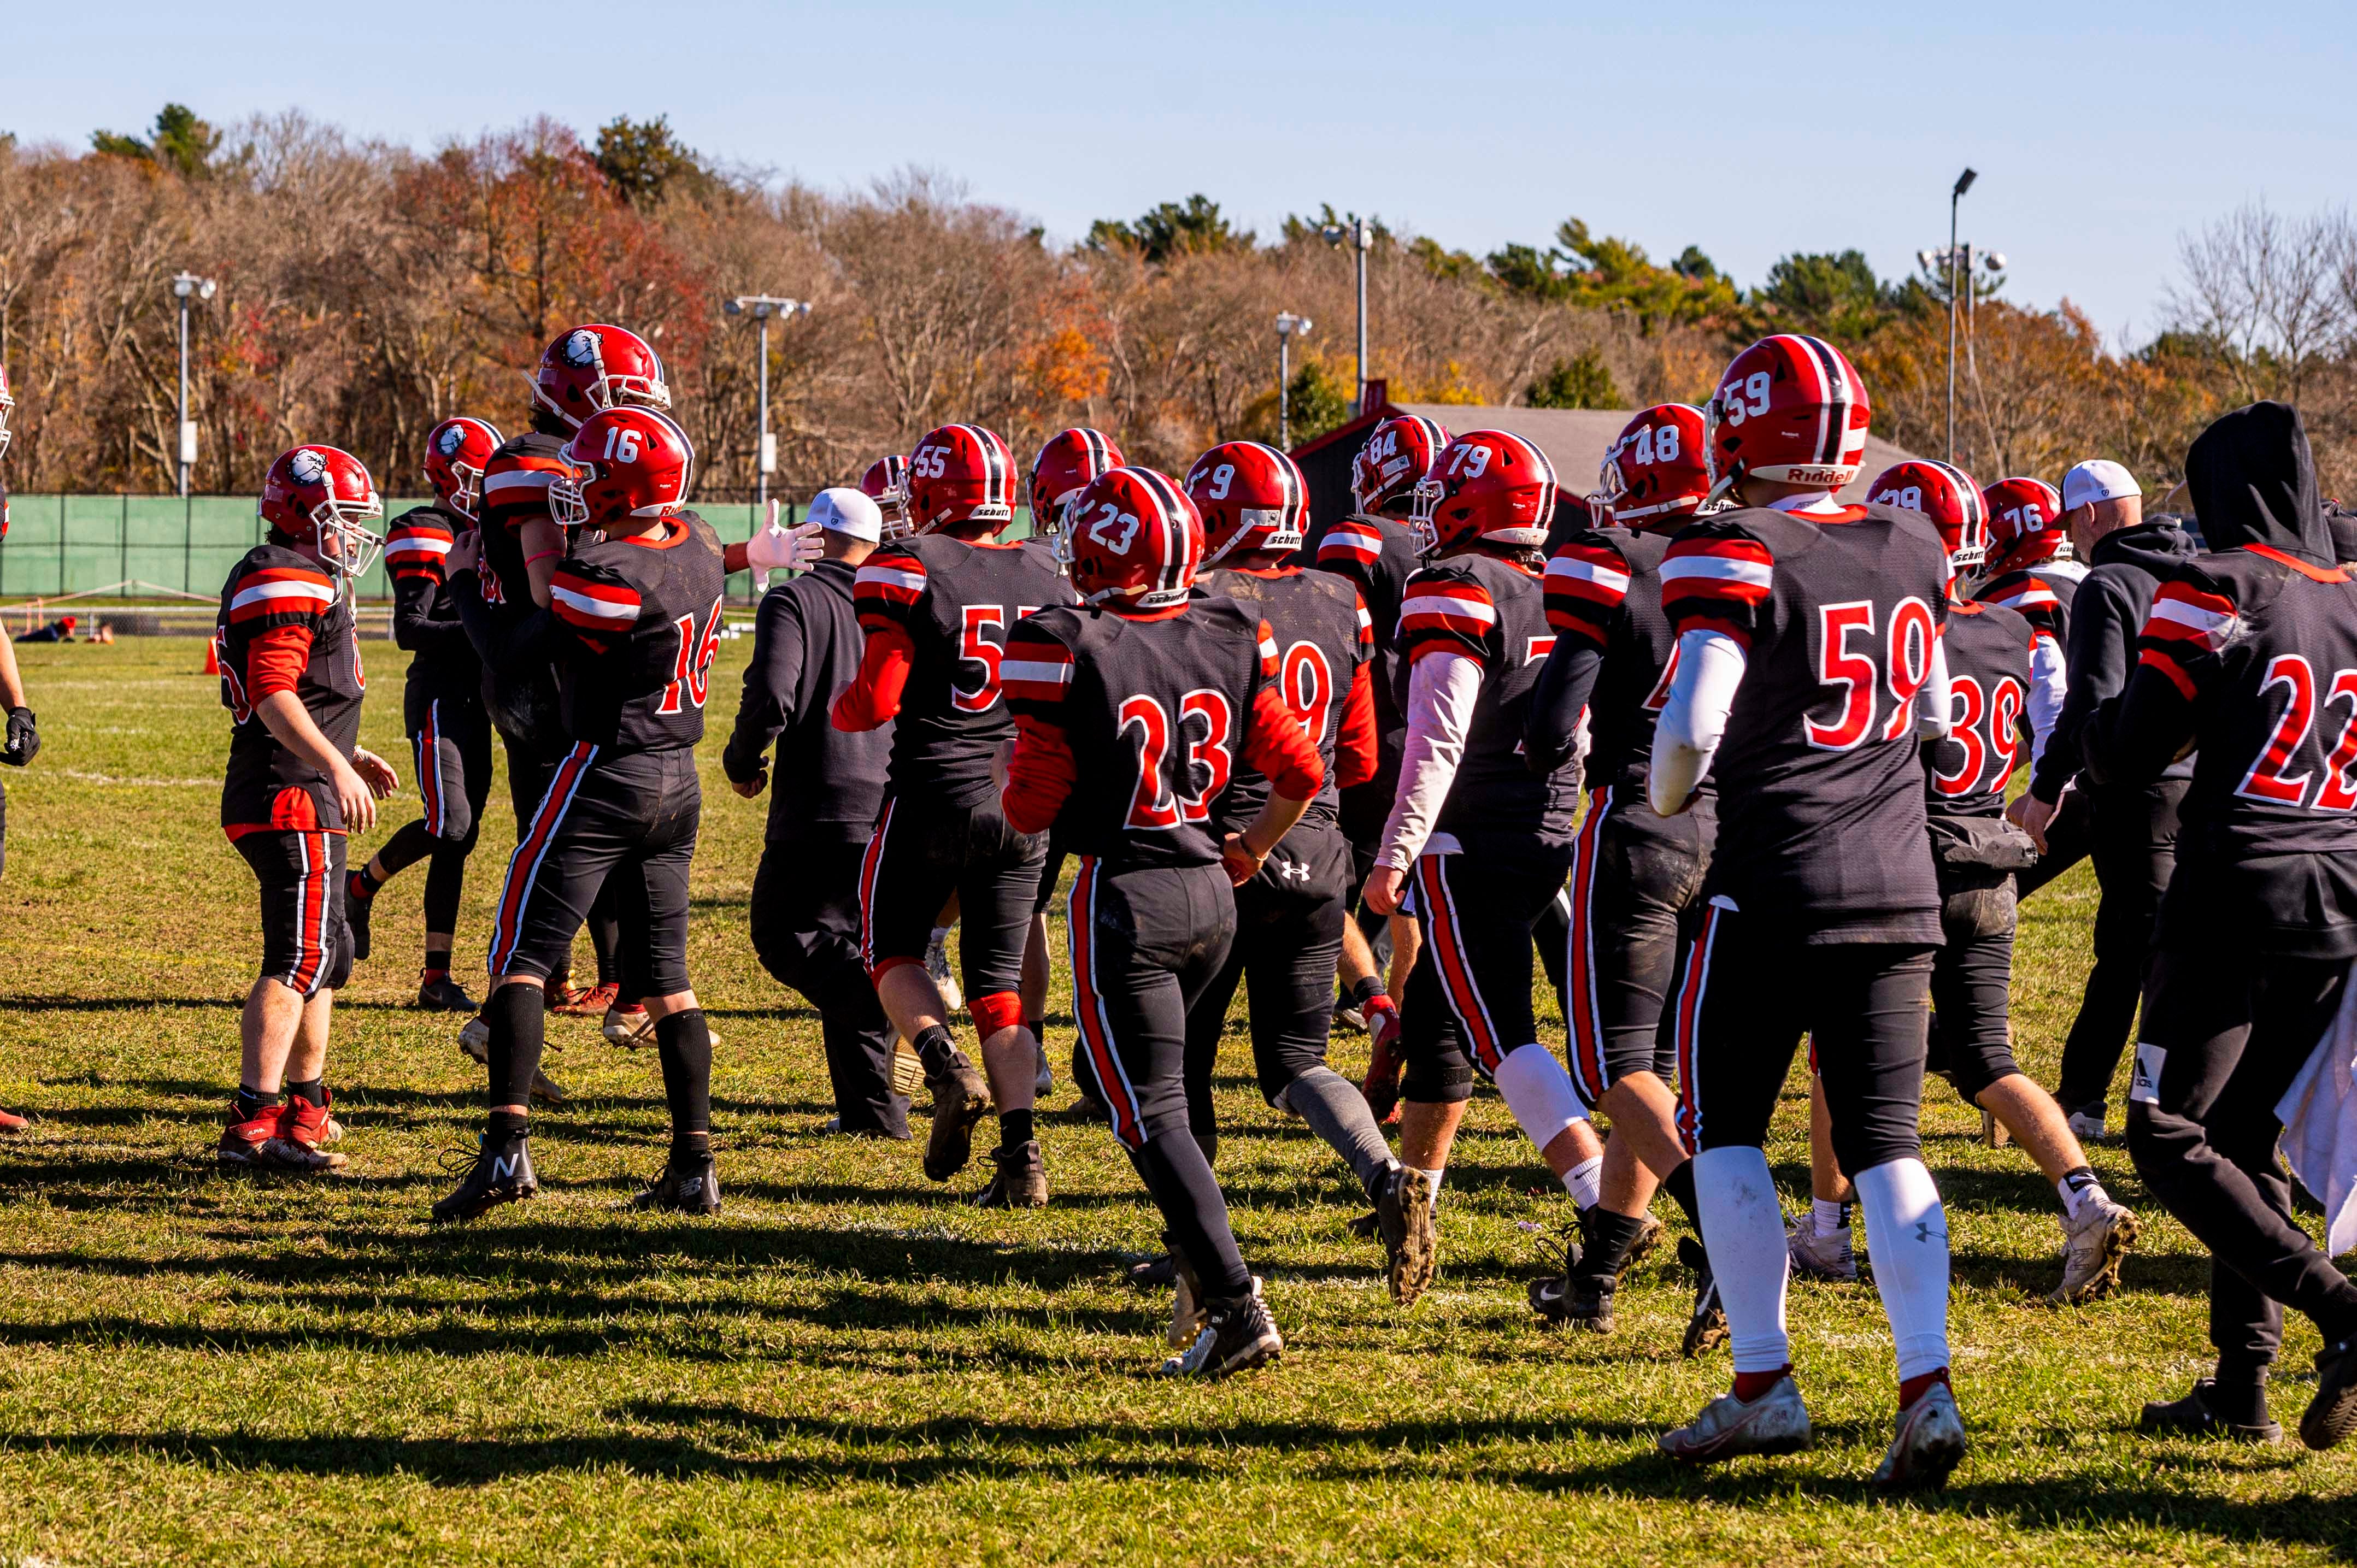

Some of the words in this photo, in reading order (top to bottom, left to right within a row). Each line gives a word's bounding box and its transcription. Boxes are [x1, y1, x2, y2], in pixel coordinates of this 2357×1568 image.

[1726, 372, 1771, 427] 59
[603, 426, 642, 463] 16
[916, 446, 951, 479] 55
[1370, 431, 1396, 465] 84
[1447, 444, 1492, 478] 79
[1636, 425, 1679, 465] 48
[1209, 464, 1235, 499] 9
[1788, 468, 1854, 483] Riddell
[978, 507, 1009, 516] schutt
[1089, 503, 1139, 555] 23
[2003, 503, 2044, 538] 76
[1271, 534, 1301, 545] schutt
[1955, 551, 1984, 562] schutt
[655, 594, 722, 715] 16
[951, 604, 1042, 712] 5
[1803, 596, 1936, 751] 59
[1280, 640, 1333, 747] 9
[1931, 675, 2023, 798] 39
[2233, 653, 2357, 812] 22
[1116, 688, 1231, 830] 23
[248, 1128, 266, 1136] ALPHA
[492, 1153, 519, 1182] N
